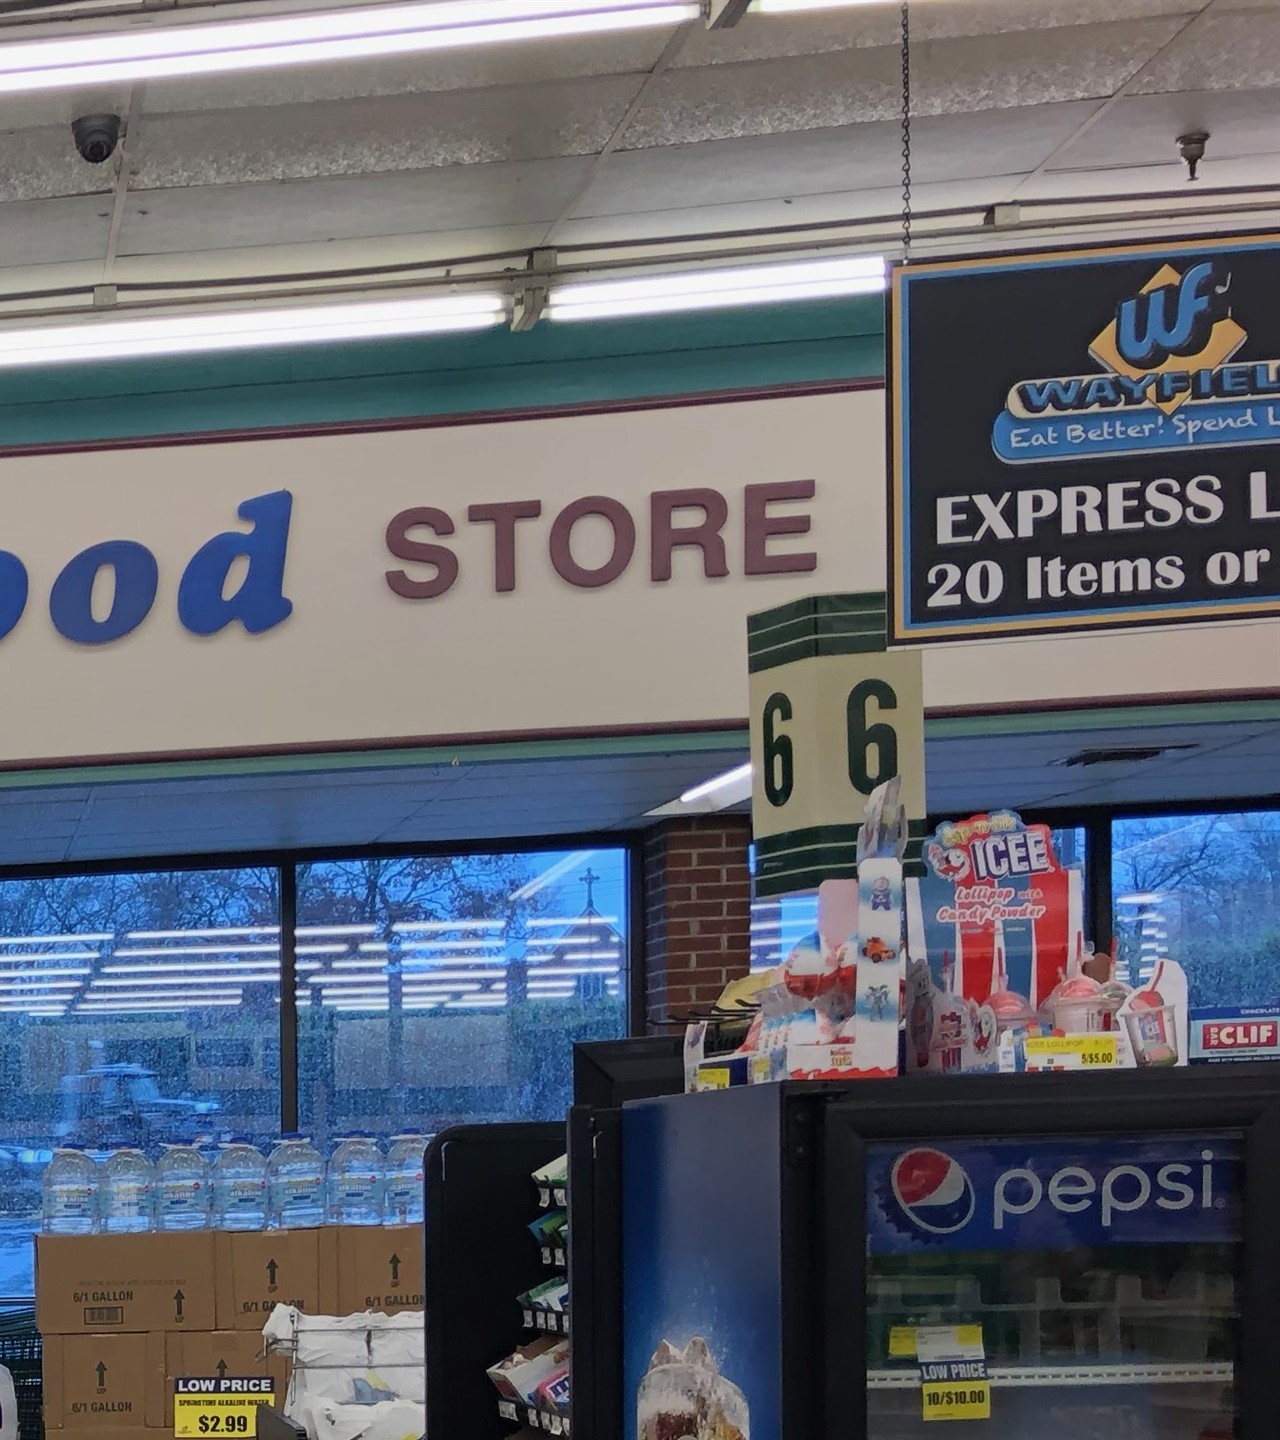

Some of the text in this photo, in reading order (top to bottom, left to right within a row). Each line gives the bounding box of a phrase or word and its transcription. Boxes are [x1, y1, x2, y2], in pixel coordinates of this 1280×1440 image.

[1020, 363, 1280, 413] WAYFIEL
[1010, 427, 1058, 448] Eat
[1067, 416, 1164, 443] Better!
[1172, 408, 1256, 443] Spend
[936, 474, 1225, 544] EXPRESS
[385, 478, 819, 600] STORE
[927, 548, 1271, 608] 20 Items or
[846, 678, 899, 796] 6
[762, 691, 794, 807] 6
[970, 831, 1051, 881] ICEE
[957, 887, 1014, 903] Lollipop
[938, 905, 1045, 924] Candy Powder
[1219, 1024, 1274, 1047] CLIF
[993, 1149, 1216, 1230] pepsi
[73, 1291, 134, 1302] 6/1 GALLON
[261, 1299, 304, 1312] GAON
[922, 1363, 986, 1380] LOW PRICE
[178, 1379, 271, 1392] LOW PRICE
[72, 1402, 132, 1413] 6/1 GALLON
[925, 1389, 986, 1407] 10/$10.00
[198, 1414, 248, 1433] $2.99
